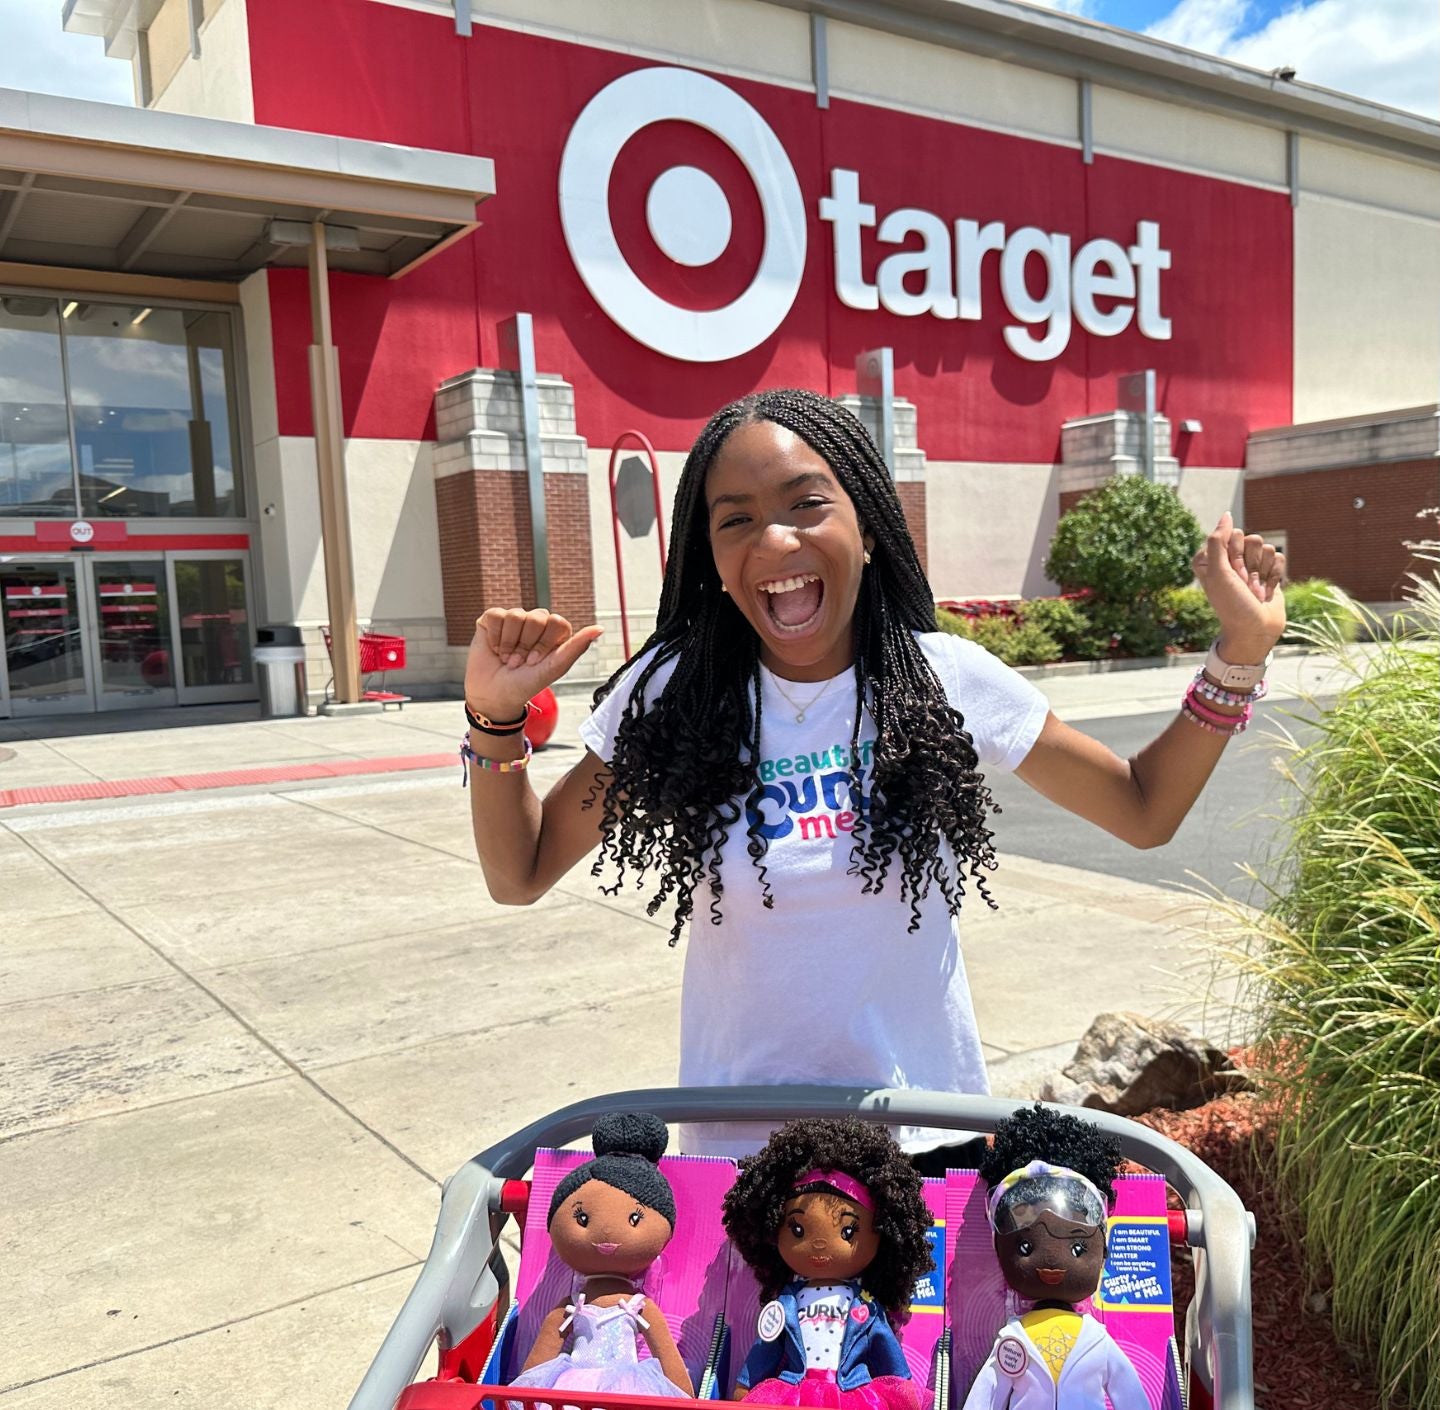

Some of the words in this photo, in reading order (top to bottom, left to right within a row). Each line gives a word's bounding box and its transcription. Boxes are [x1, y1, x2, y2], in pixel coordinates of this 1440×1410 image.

[819, 168, 1172, 362] target
[72, 528, 91, 536] OUT
[760, 740, 876, 782] Beautf
[746, 769, 871, 840] Cur
[798, 811, 856, 840] me
[797, 1304, 848, 1322] CURLY
